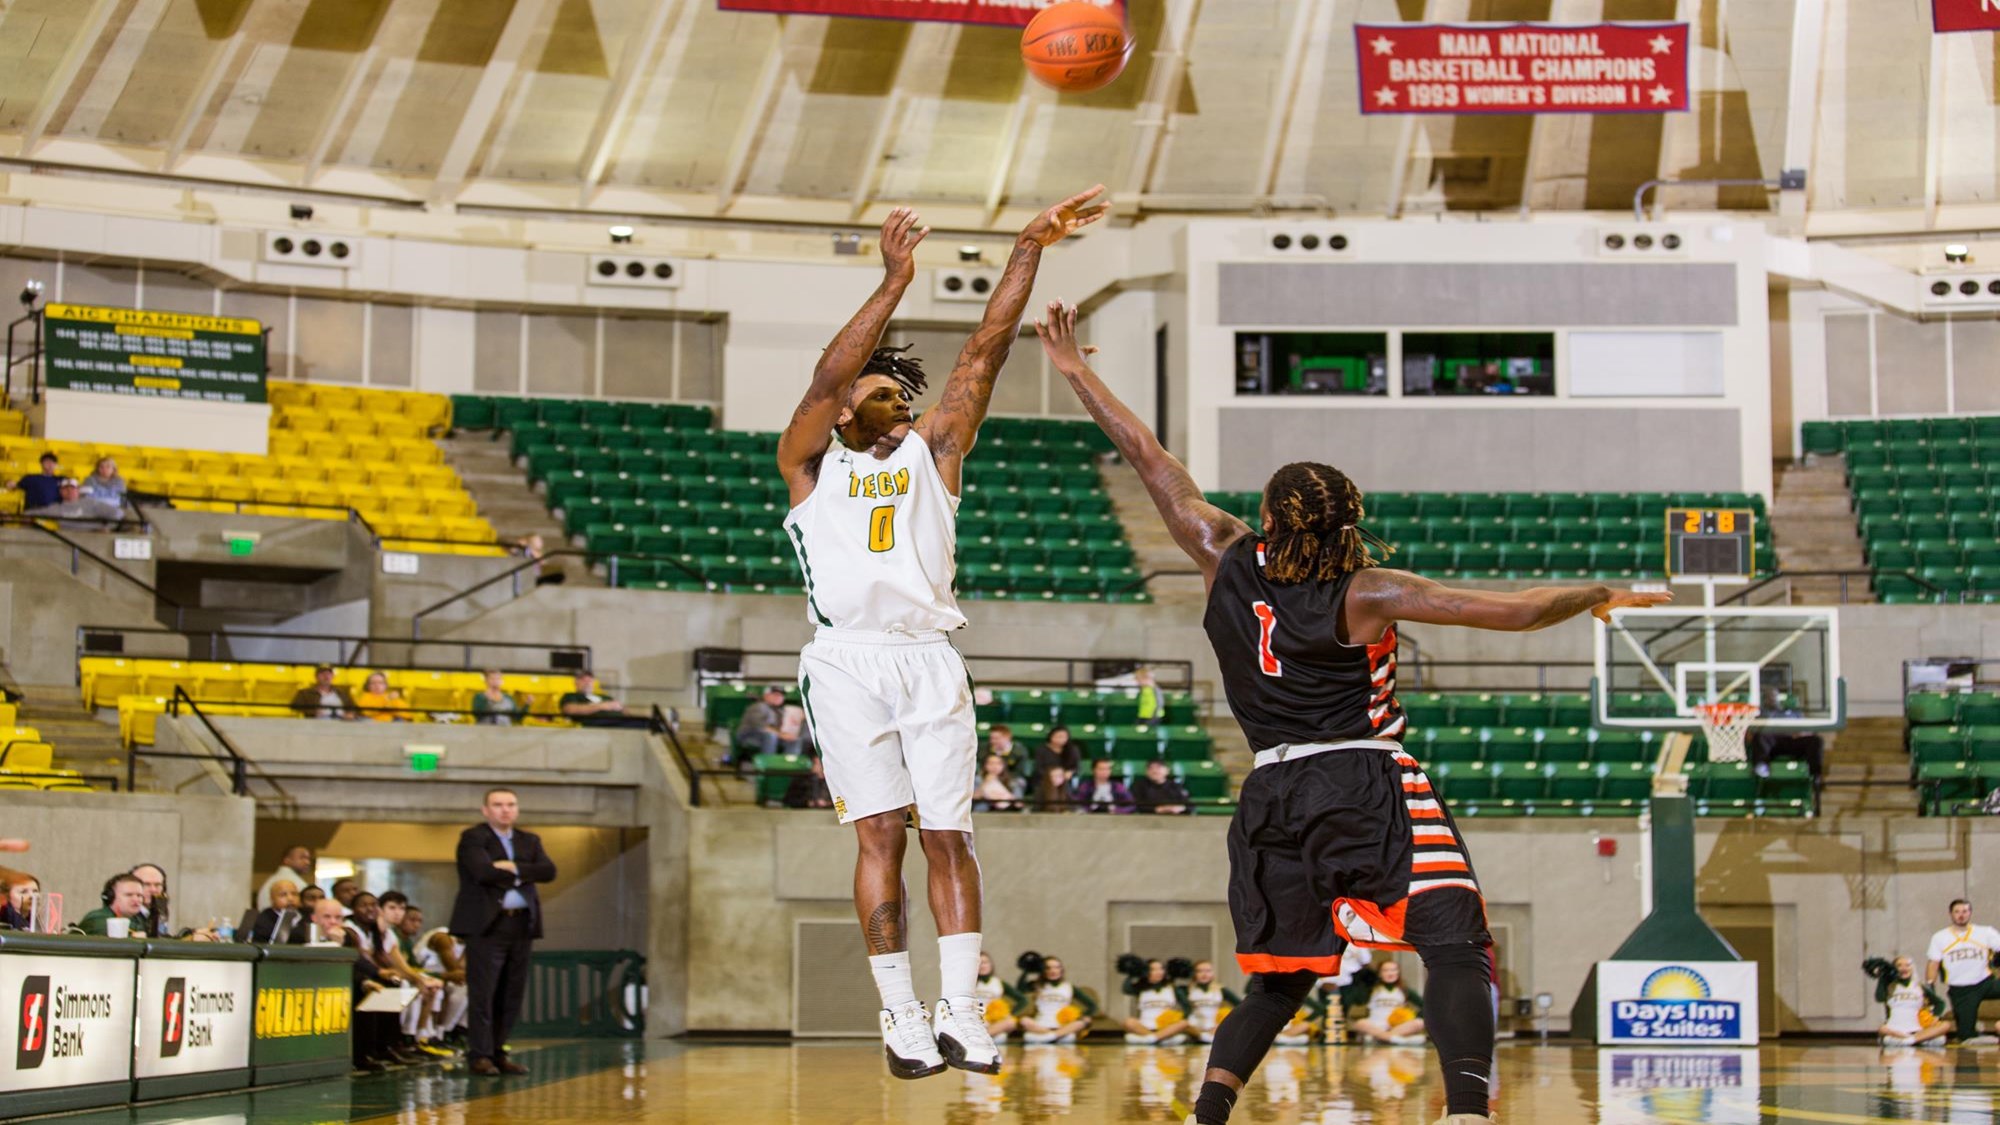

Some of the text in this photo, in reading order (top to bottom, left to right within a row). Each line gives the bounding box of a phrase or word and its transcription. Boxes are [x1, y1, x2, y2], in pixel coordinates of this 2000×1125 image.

[1439, 33, 1604, 57] NAIA NATIONAL
[1389, 58, 1656, 82] BASKETBALL CHAMPIONS
[1408, 84, 1460, 107] 1993
[1464, 85, 1546, 105] WOMEN'S
[1552, 85, 1627, 105] DIVISION
[107, 310, 244, 333] CHAMPIONS
[848, 467, 910, 499] TECH
[868, 504, 896, 553] 0
[1252, 600, 1283, 678] 1
[1948, 947, 1984, 963] TECH
[54, 985, 112, 1020] Simmons
[189, 985, 235, 1015] Simmons
[255, 987, 314, 1040] GOLDEN
[1617, 1001, 1735, 1022] Days Inn
[51, 1021, 85, 1058] Bank
[187, 1017, 214, 1049] Bank
[1631, 1019, 1722, 1038] & Suites
